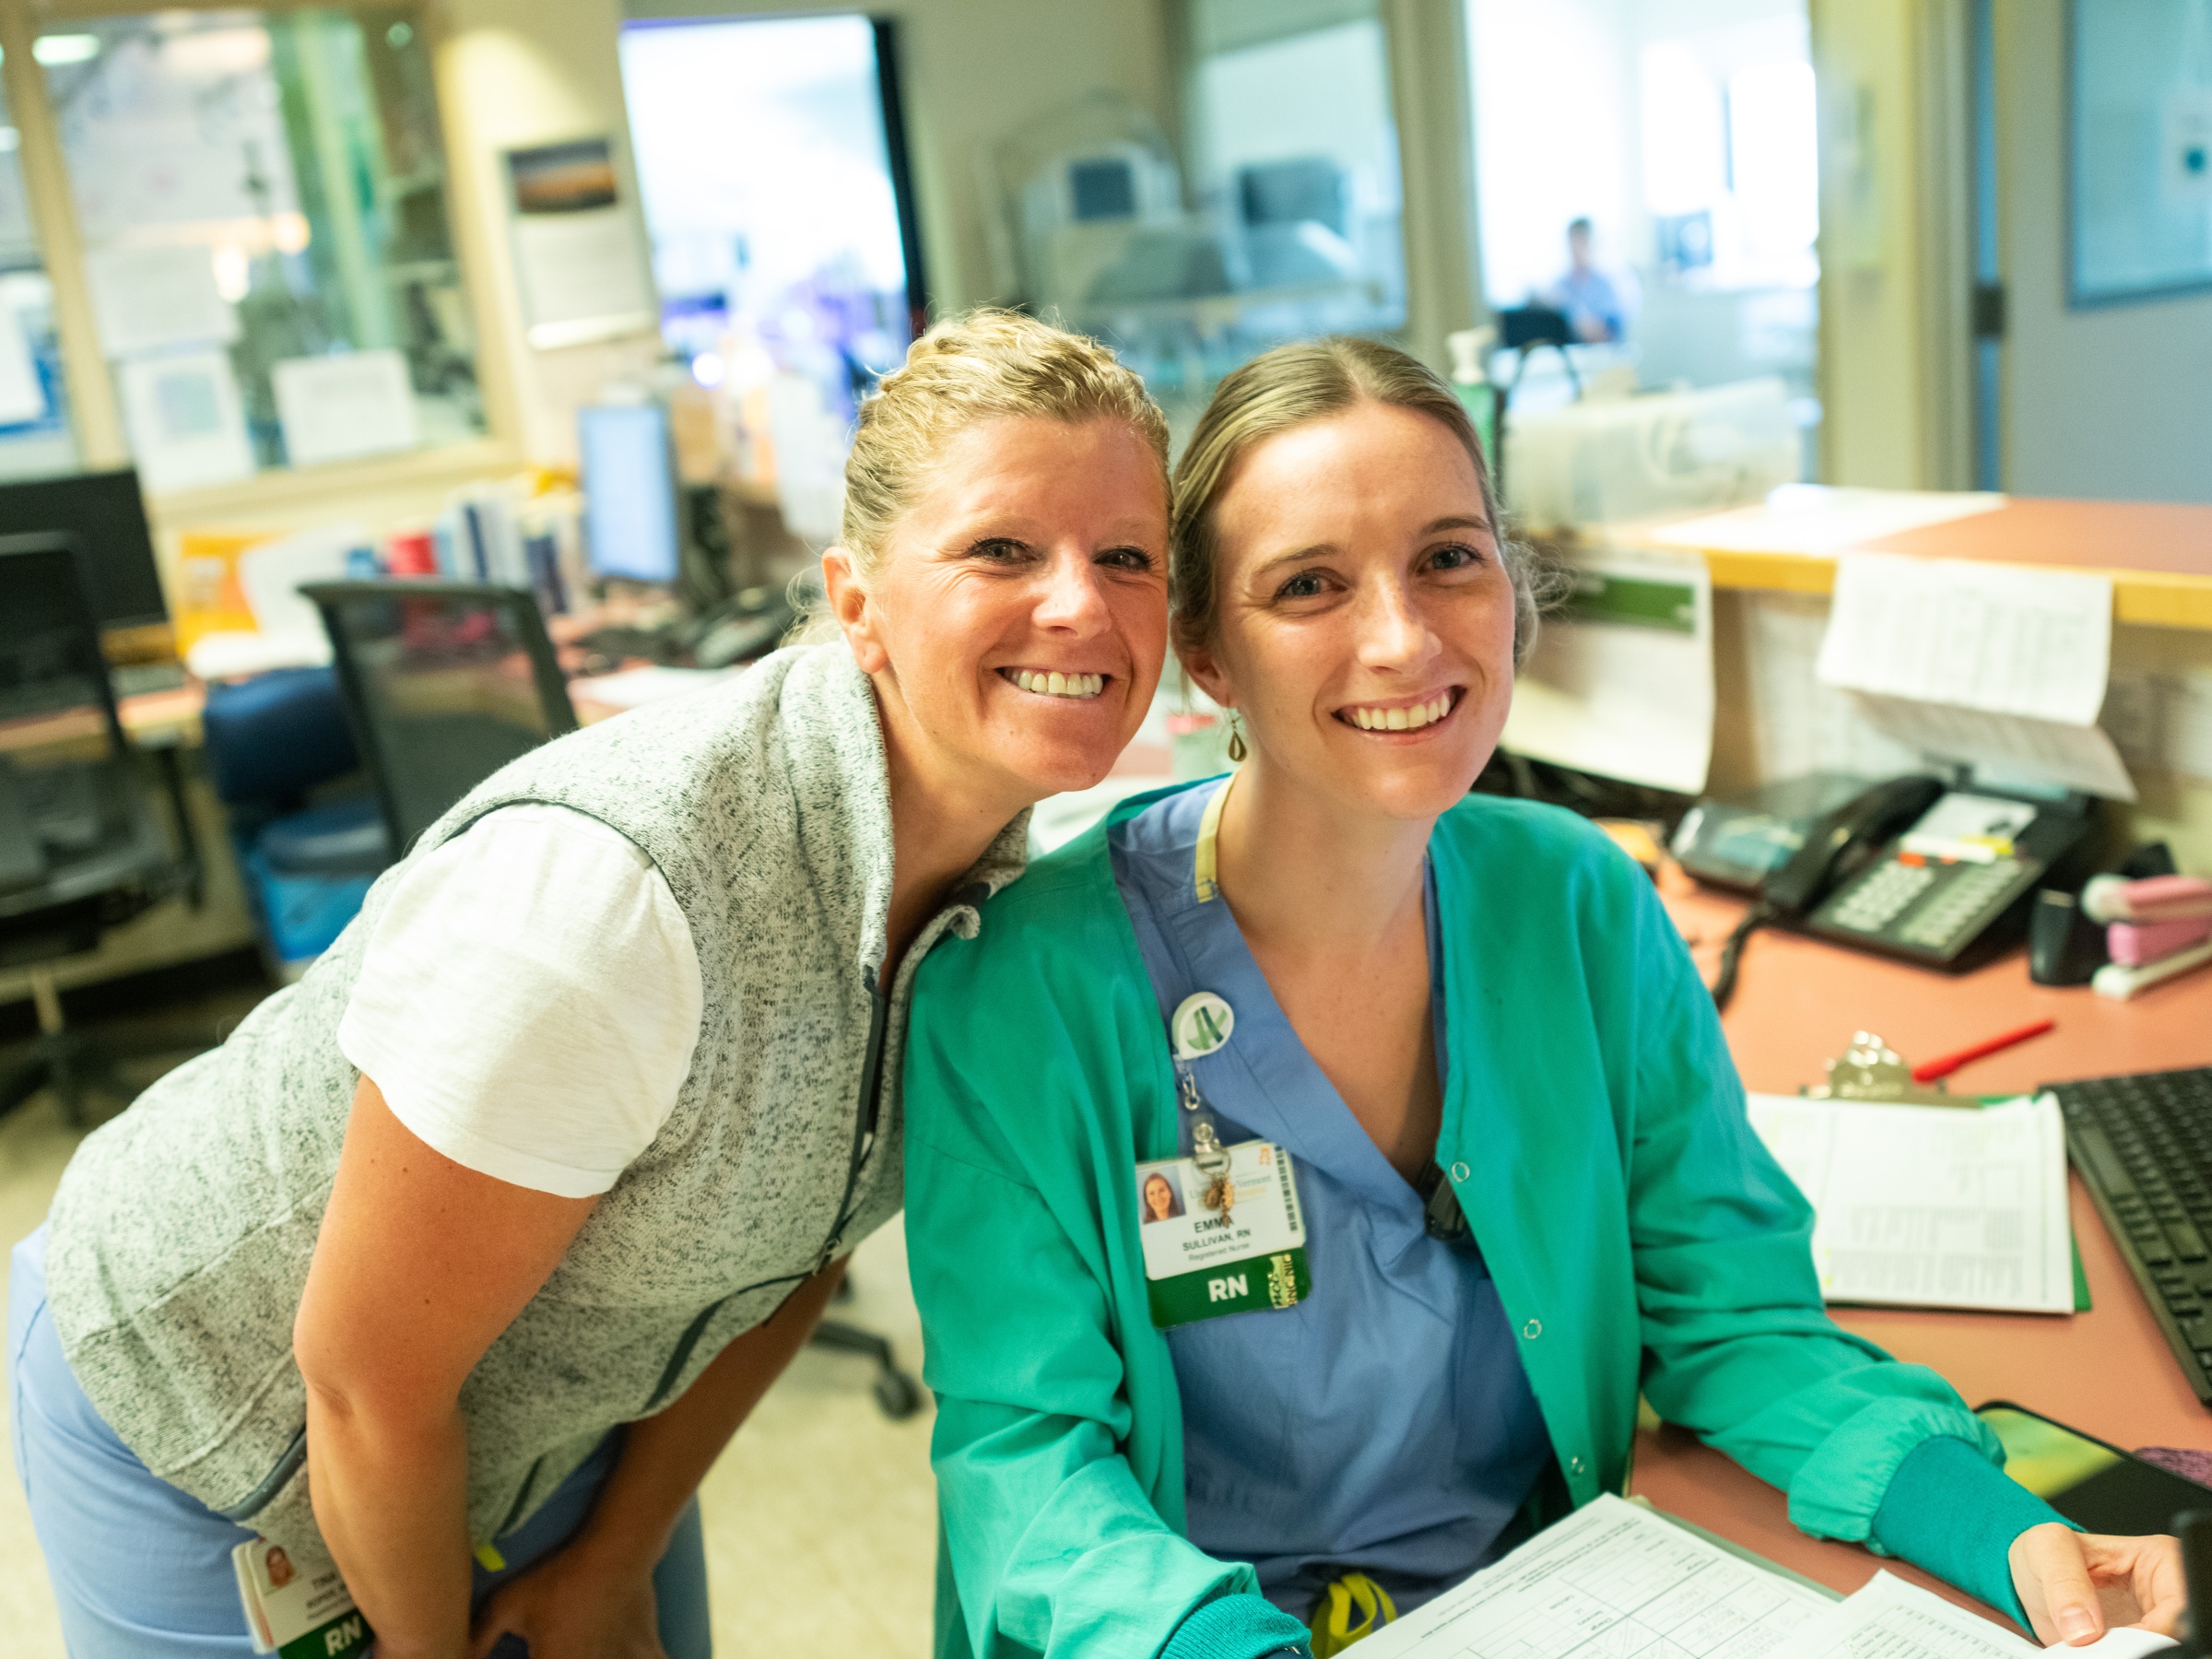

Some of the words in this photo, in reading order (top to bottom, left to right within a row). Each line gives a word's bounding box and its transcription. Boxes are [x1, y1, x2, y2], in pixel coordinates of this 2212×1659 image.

[1182, 1233, 1234, 1251] SULLIVAN,
[1237, 1229, 1251, 1238] RN
[1188, 1248, 1228, 1261] Registered
[1229, 1242, 1250, 1252] Nurse
[1208, 1274, 1249, 1302] RN
[324, 1616, 361, 1656] RN
